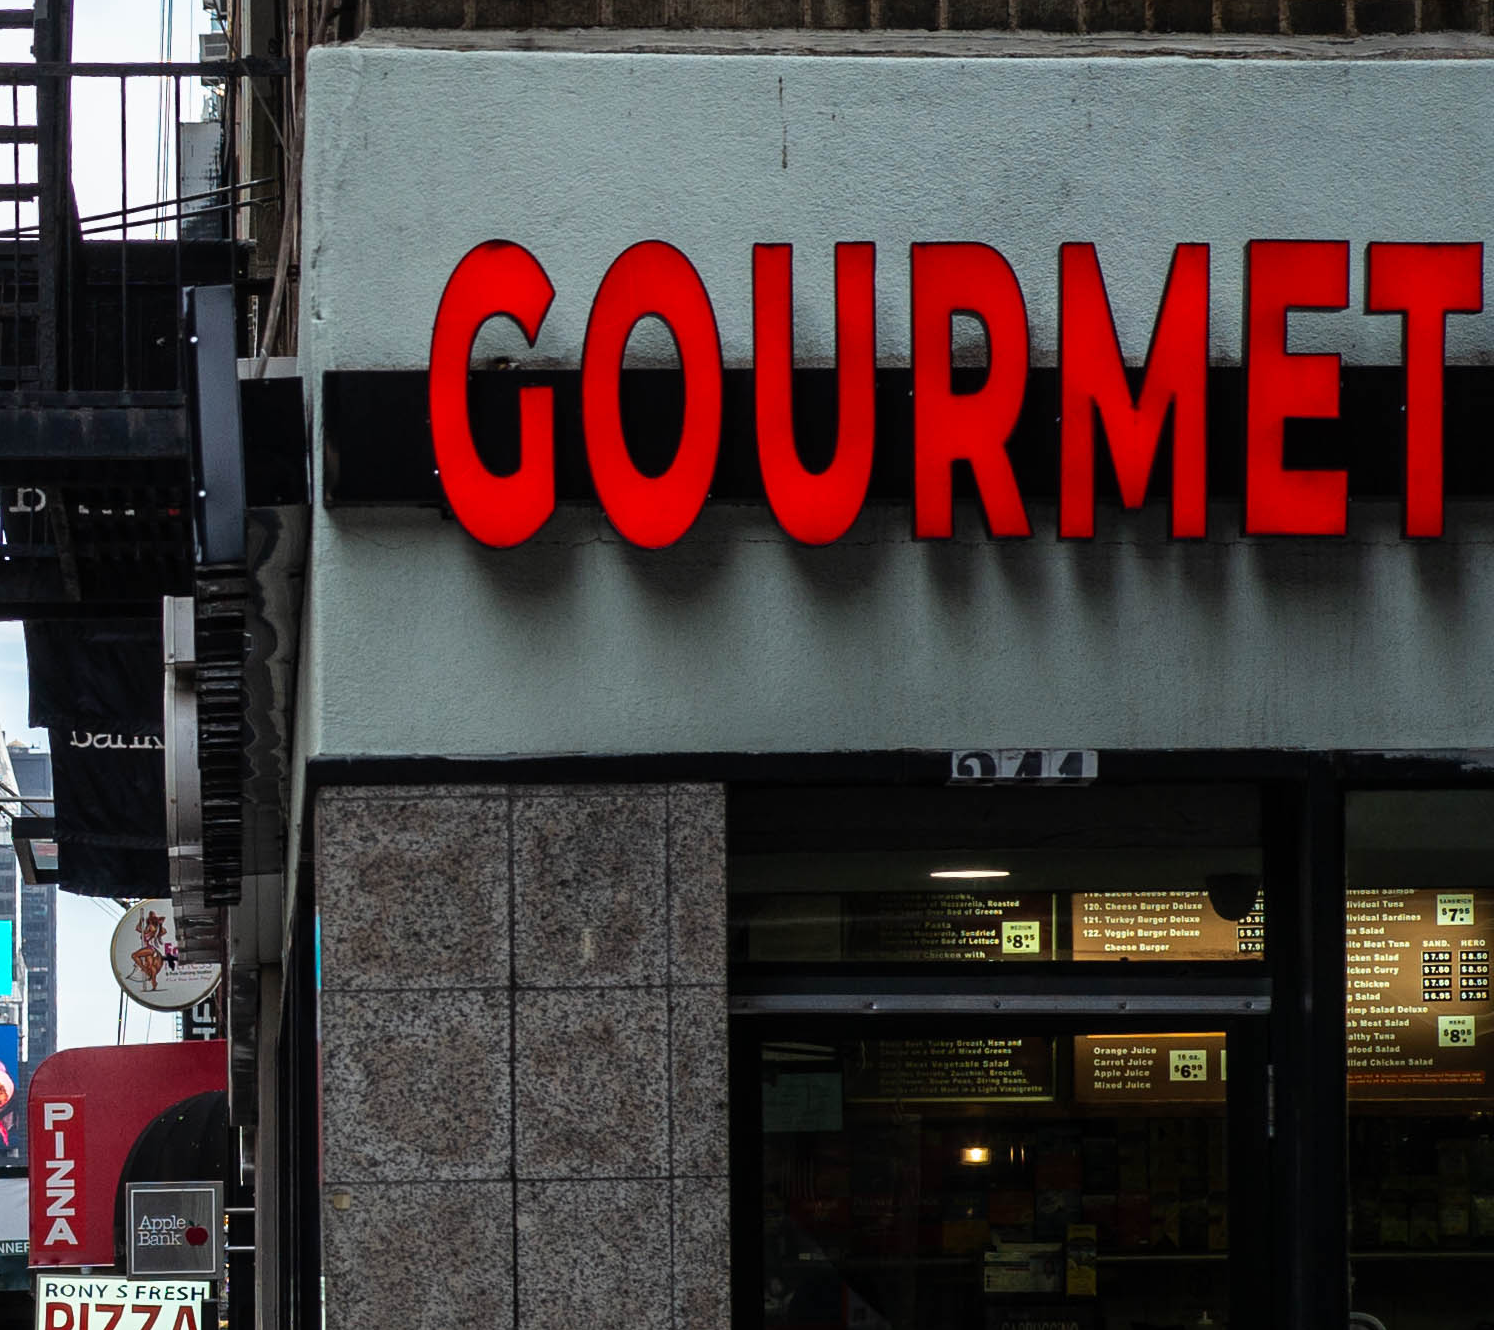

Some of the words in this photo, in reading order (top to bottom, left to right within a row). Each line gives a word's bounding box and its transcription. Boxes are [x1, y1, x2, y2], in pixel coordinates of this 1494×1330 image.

[428, 238, 1484, 550] GOURMET
[1105, 943, 1137, 951] Cheese
[1139, 943, 1169, 952] Burger
[1355, 993, 1380, 1001] Salad
[1094, 1069, 1122, 1078] Apple
[1124, 1069, 1150, 1077] Juice
[43, 1102, 78, 1246] PIZZA
[138, 1215, 186, 1235] Apple
[138, 1231, 181, 1247] Bank
[45, 1283, 109, 1300] RONY
[135, 1284, 205, 1300] FRESH
